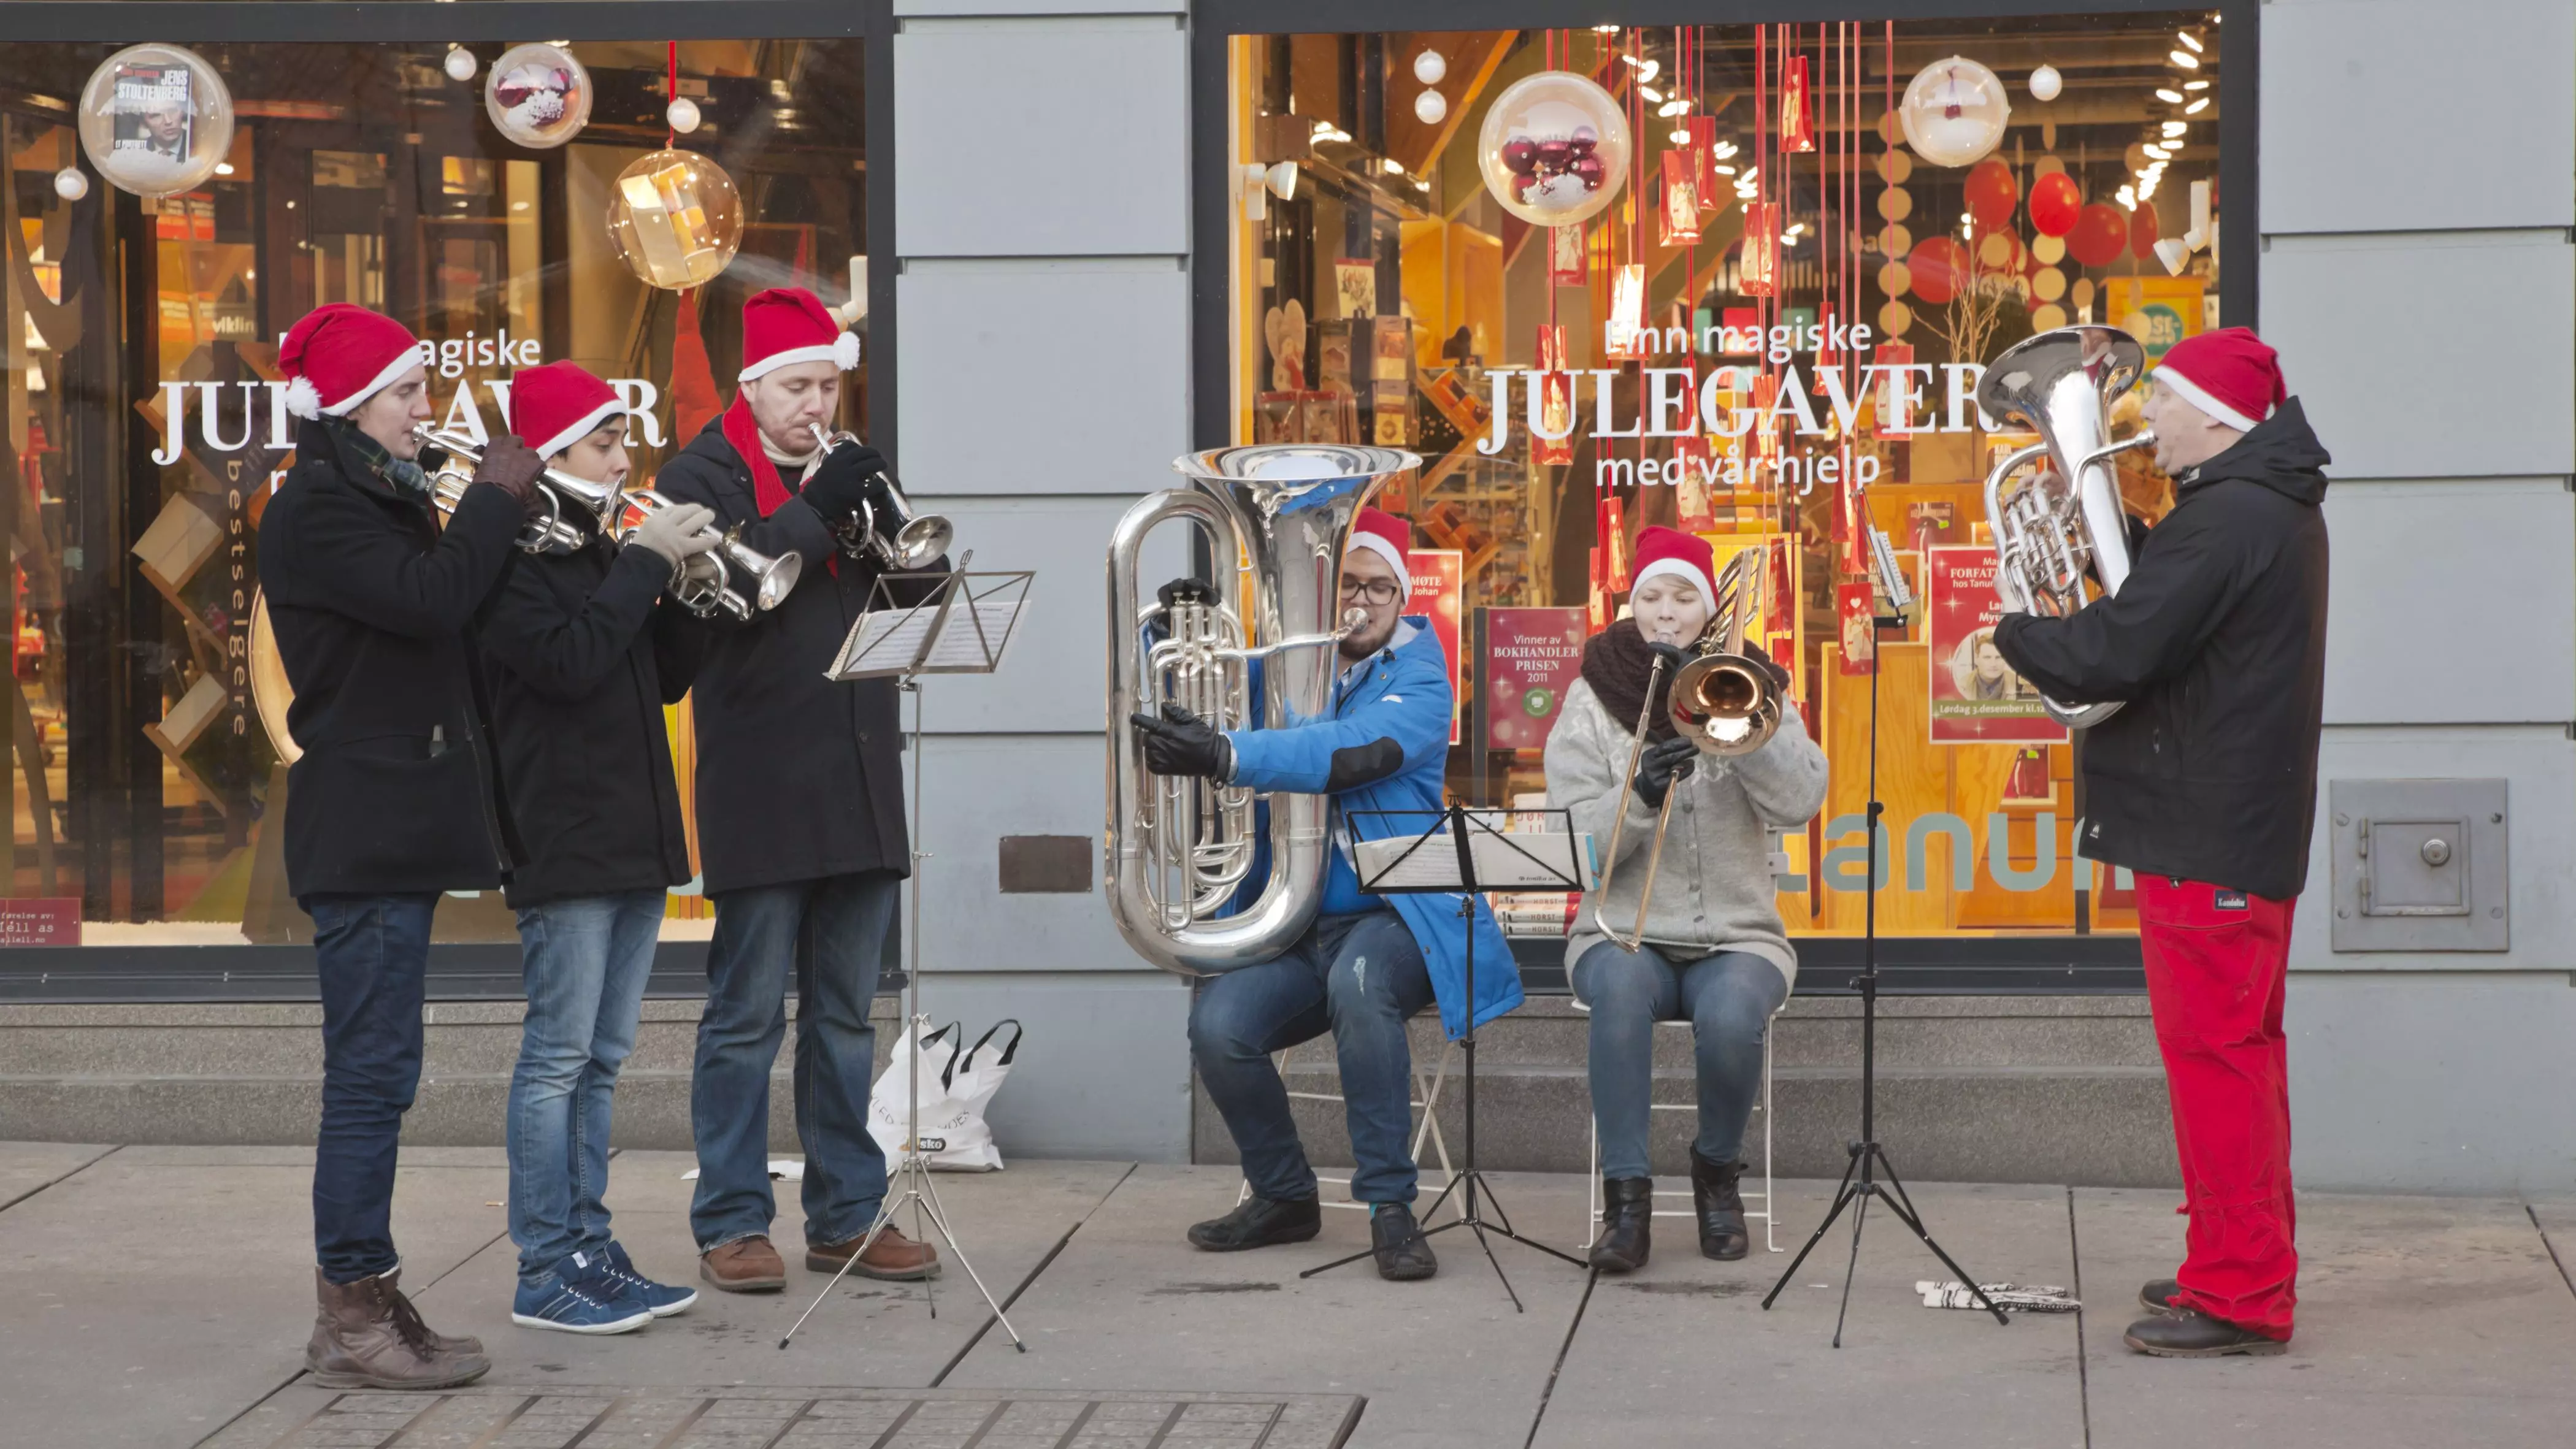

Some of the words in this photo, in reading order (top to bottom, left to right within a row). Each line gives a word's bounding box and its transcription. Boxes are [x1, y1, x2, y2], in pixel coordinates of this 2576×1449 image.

[161, 70, 188, 85] JENS
[118, 82, 187, 102] STOLTENBERG
[1604, 318, 1688, 354] Finn
[1703, 318, 1872, 364] magiske
[422, 329, 541, 378] agiske
[1476, 363, 2003, 456] JULEGAVER
[1596, 448, 1685, 486] med
[1698, 445, 1760, 484] vår
[1777, 444, 1880, 495] hjelp
[1953, 579, 1968, 588] hos
[227, 460, 249, 735] bestselgere
[1414, 587, 1439, 596] Johan
[1514, 635, 1547, 644] Vinner
[1516, 660, 1560, 671] PRISEN
[1527, 673, 1548, 682] 2011
[1940, 705, 1971, 716] Lørdag
[1972, 705, 2023, 714] 3.desember
